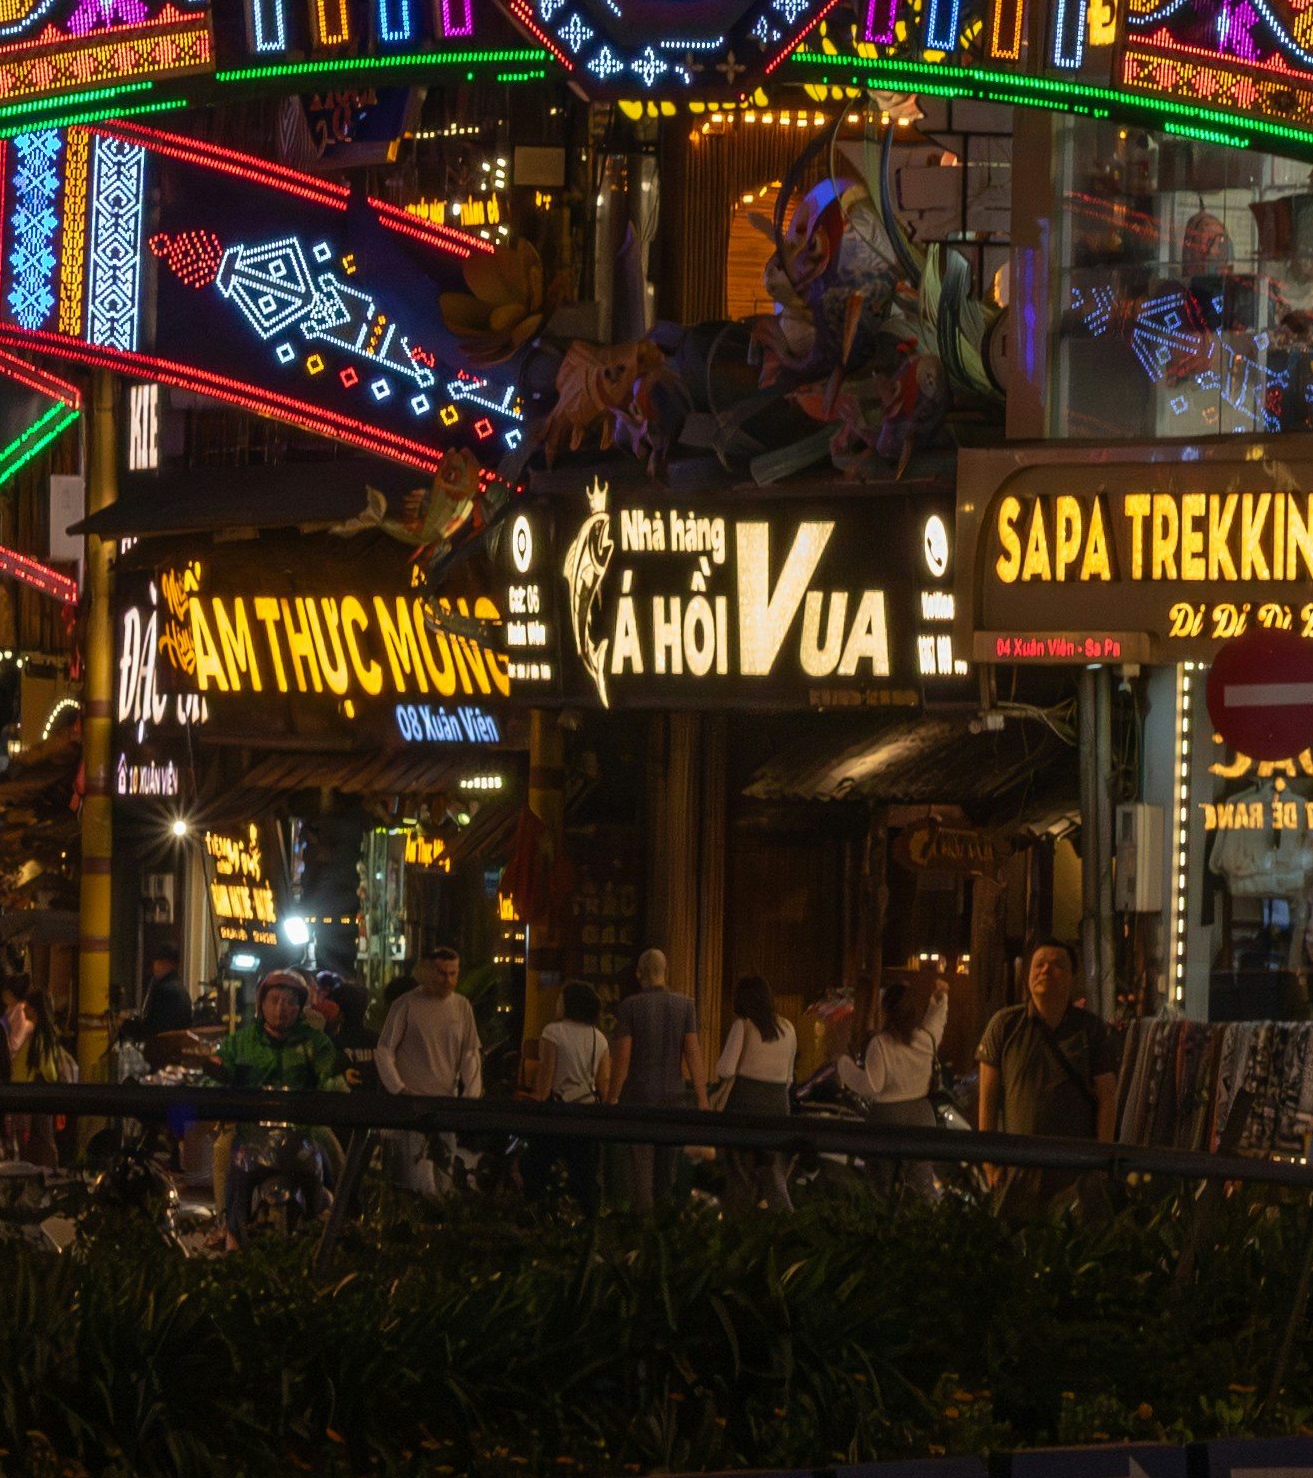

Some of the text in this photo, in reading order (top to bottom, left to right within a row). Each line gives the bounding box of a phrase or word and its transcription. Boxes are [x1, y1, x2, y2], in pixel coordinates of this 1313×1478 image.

[621, 509, 725, 565] Nhà hàng
[995, 493, 1112, 584] SAPA
[652, 520, 890, 677] HỒI VUA
[253, 595, 383, 719] THỰC
[996, 637, 1011, 657] 04
[1013, 637, 1045, 657] Xuân
[1085, 637, 1102, 657] Sa
[1104, 638, 1121, 657] Pa
[395, 702, 501, 744] 08 Xuân Viên
